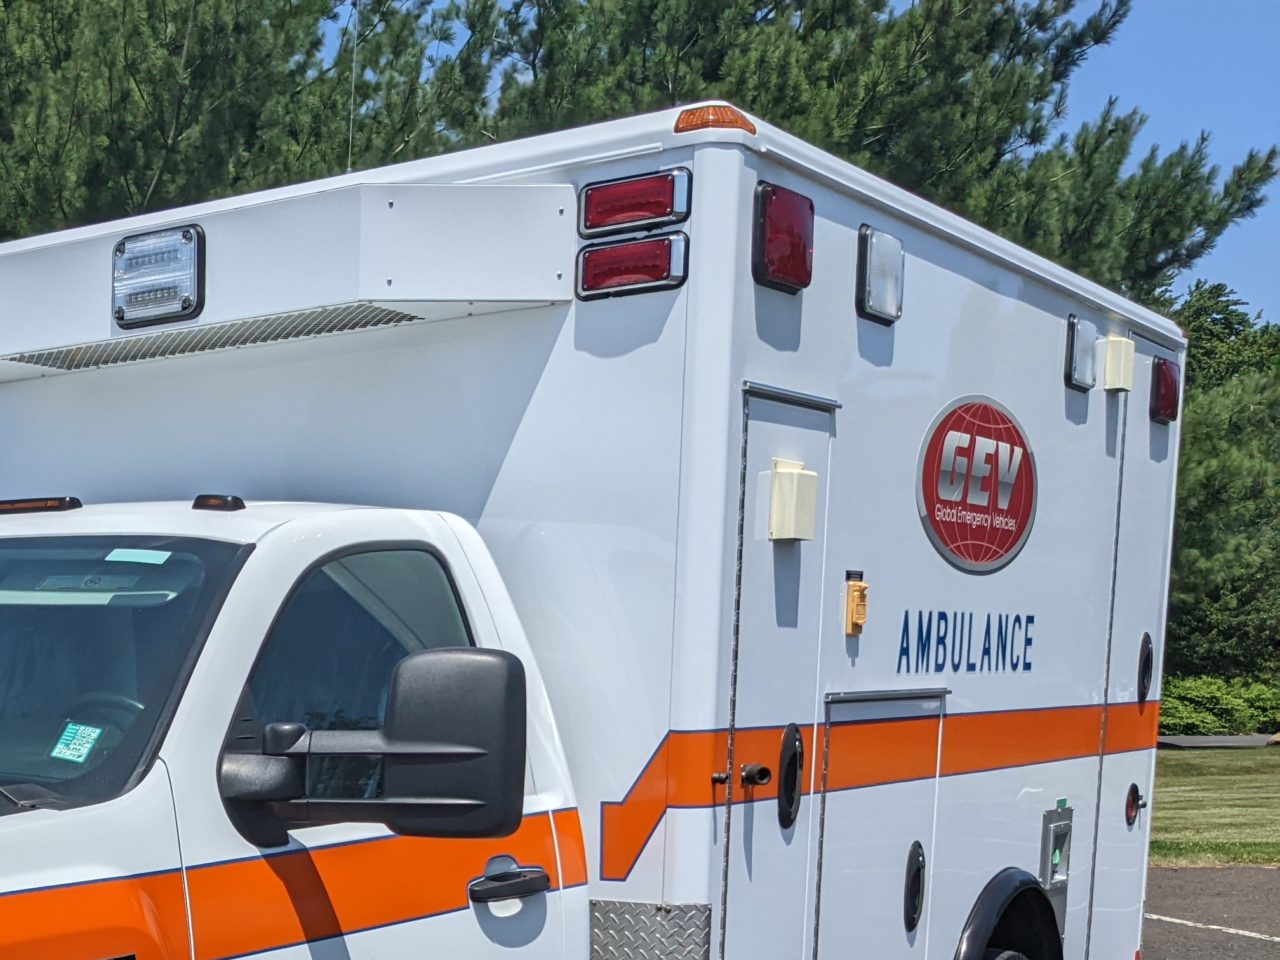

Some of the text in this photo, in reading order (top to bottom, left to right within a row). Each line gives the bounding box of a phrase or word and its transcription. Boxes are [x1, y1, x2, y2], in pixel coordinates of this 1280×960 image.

[937, 430, 1023, 510] GEV
[935, 503, 1016, 531] Global Emergency Vehicles
[896, 609, 1035, 674] AMBULANCE
